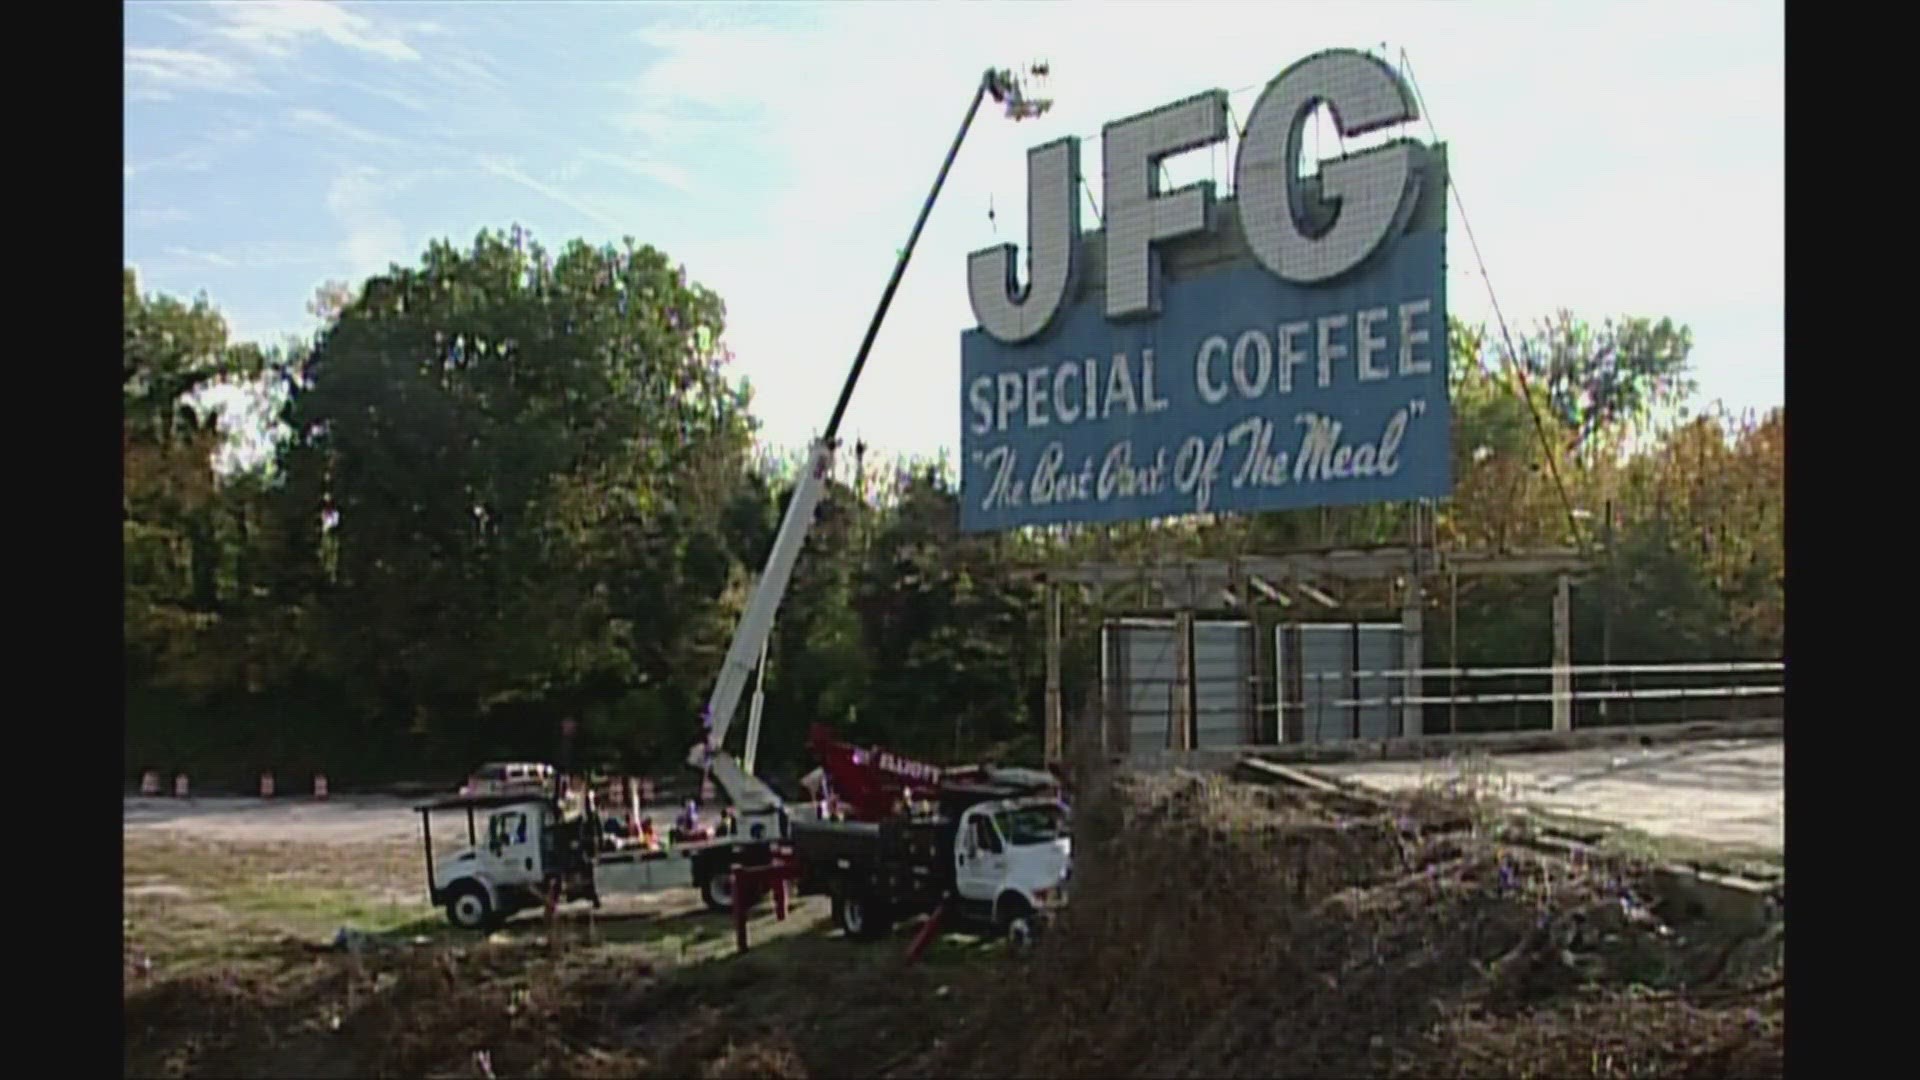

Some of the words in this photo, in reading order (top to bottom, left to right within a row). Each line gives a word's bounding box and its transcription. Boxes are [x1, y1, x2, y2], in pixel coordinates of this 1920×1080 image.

[967, 48, 1420, 342] JFG
[969, 348, 1168, 435] SPECIAL
[1196, 298, 1432, 403] COFFEE
[1030, 441, 1092, 505] Best
[1097, 440, 1165, 501] Part
[1173, 433, 1223, 512] Of
[1228, 415, 1288, 489] The
[880, 753, 941, 784] ELLIOTT
